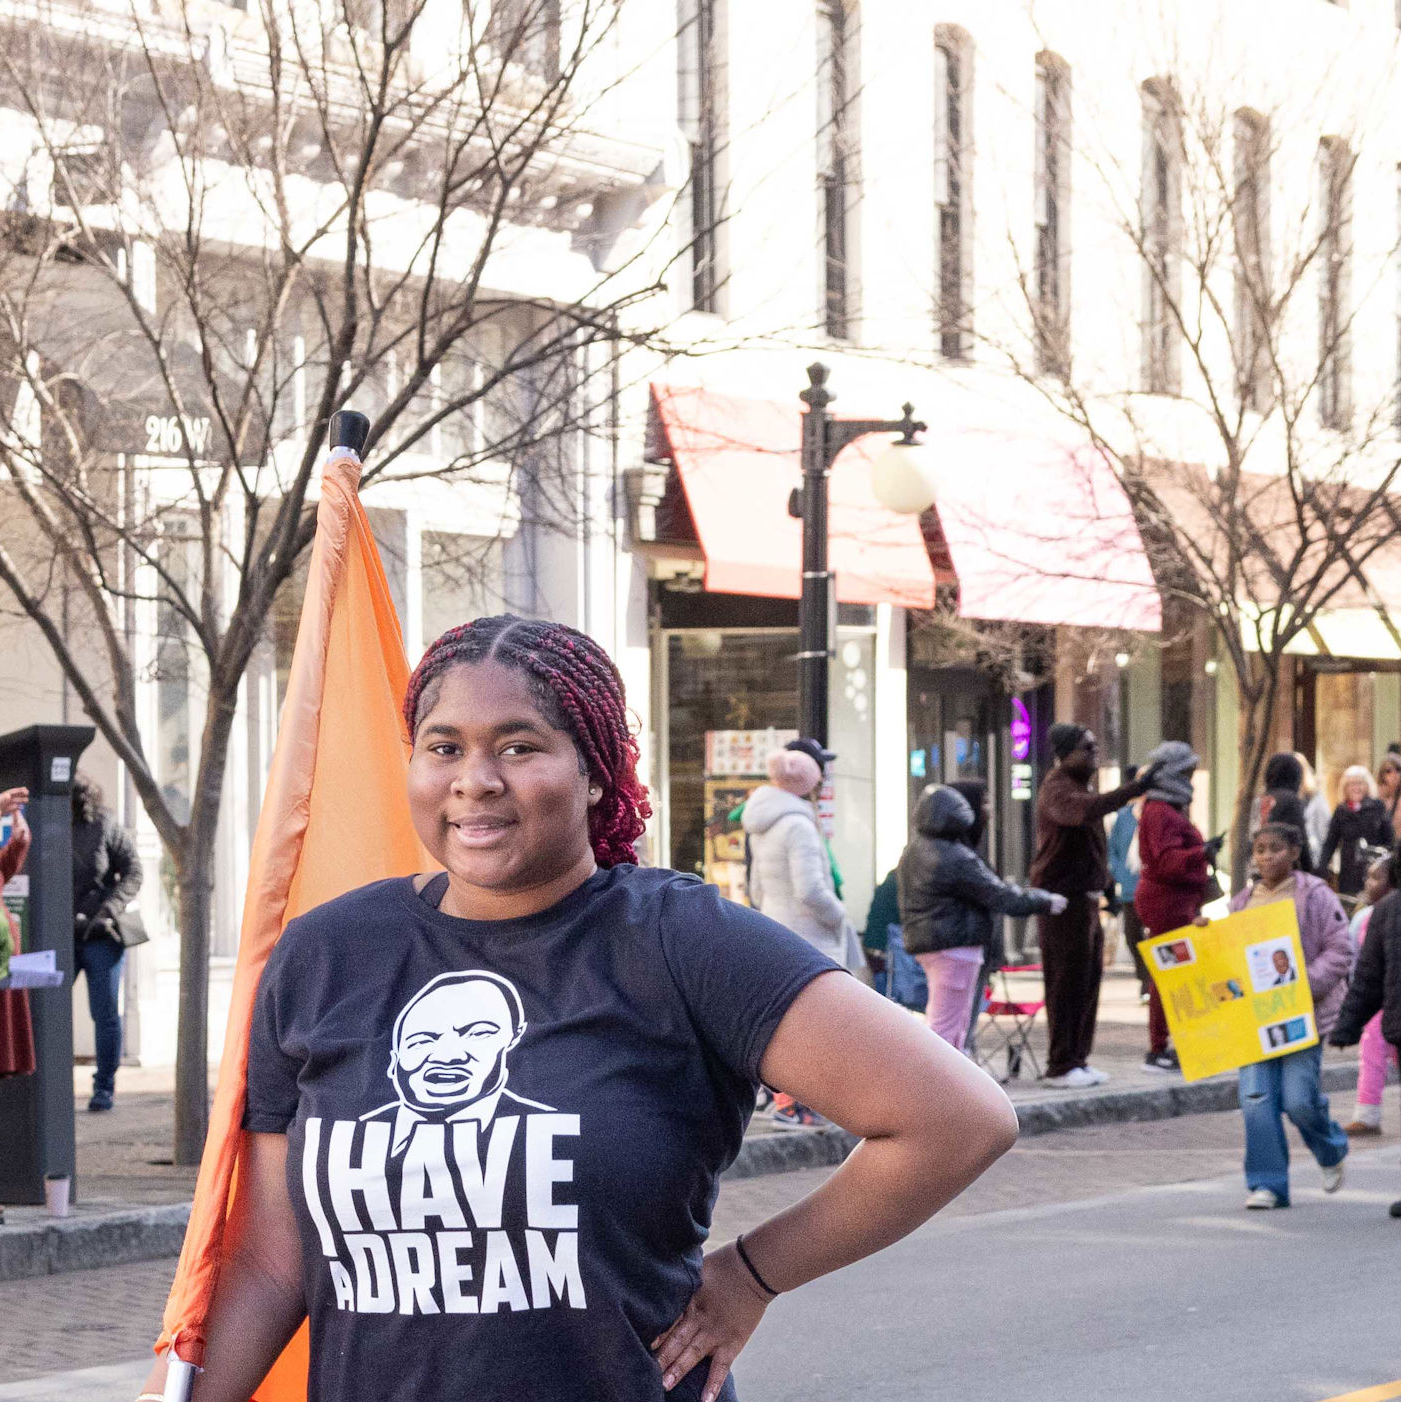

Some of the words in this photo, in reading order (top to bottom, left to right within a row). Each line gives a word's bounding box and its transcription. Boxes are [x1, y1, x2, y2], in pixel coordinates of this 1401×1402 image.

[145, 415, 183, 453] 216
[302, 1117, 338, 1257] I
[327, 1113, 581, 1232] HAVE
[329, 1260, 355, 1312] A
[343, 1229, 587, 1316] DREAM
